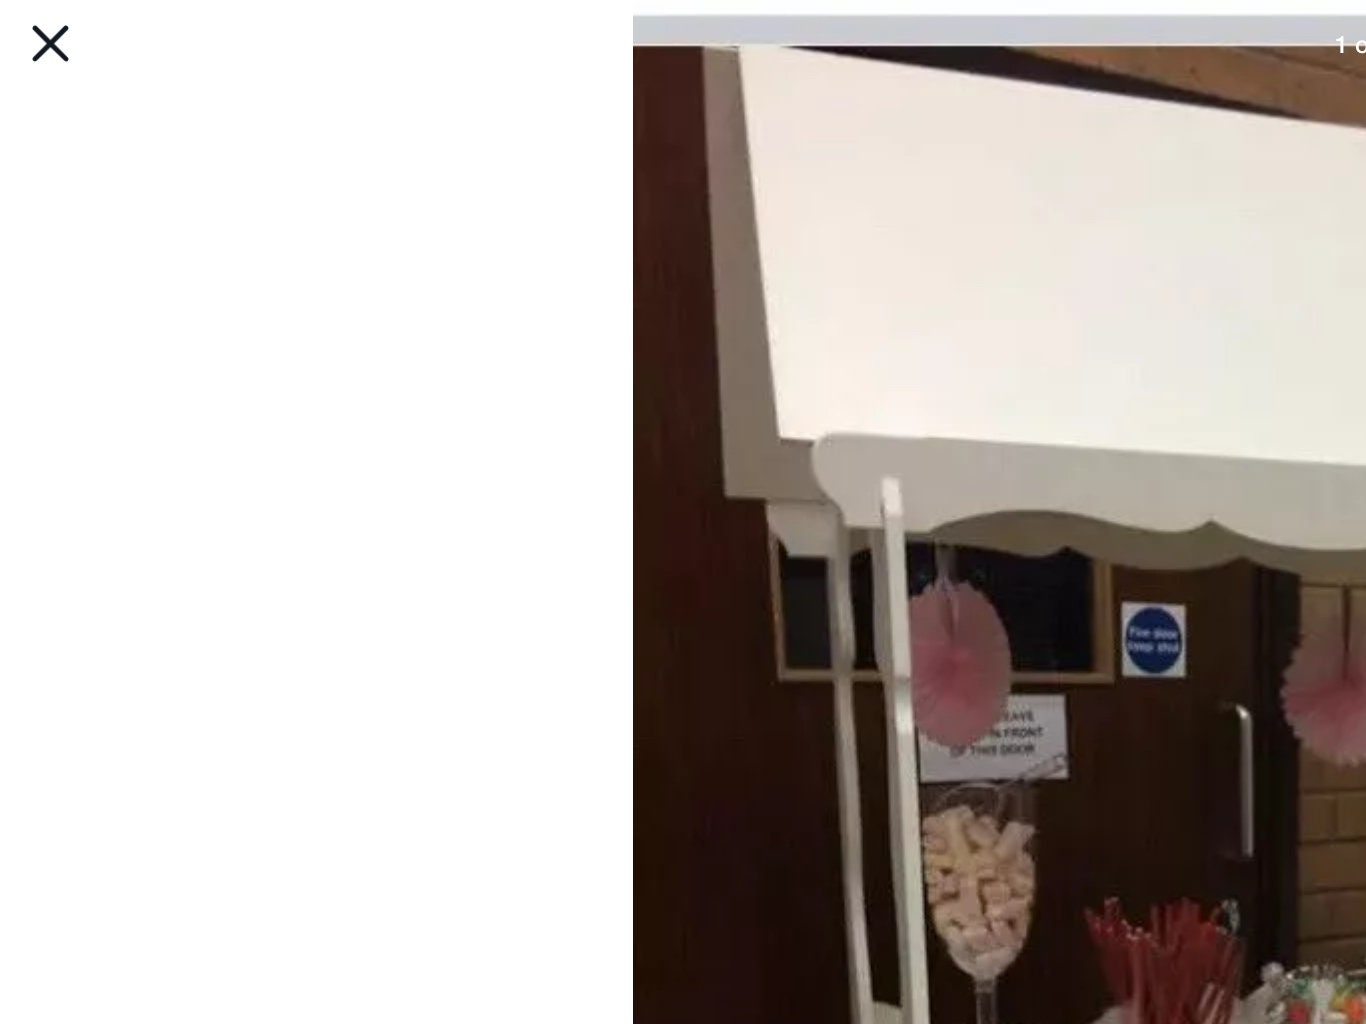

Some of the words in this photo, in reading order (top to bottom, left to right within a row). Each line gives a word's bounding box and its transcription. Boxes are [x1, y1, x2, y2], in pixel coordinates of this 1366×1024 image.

[1004, 726, 1044, 738] FRONT
[971, 745, 998, 755] THIS
[1000, 744, 1036, 757] DOOR
